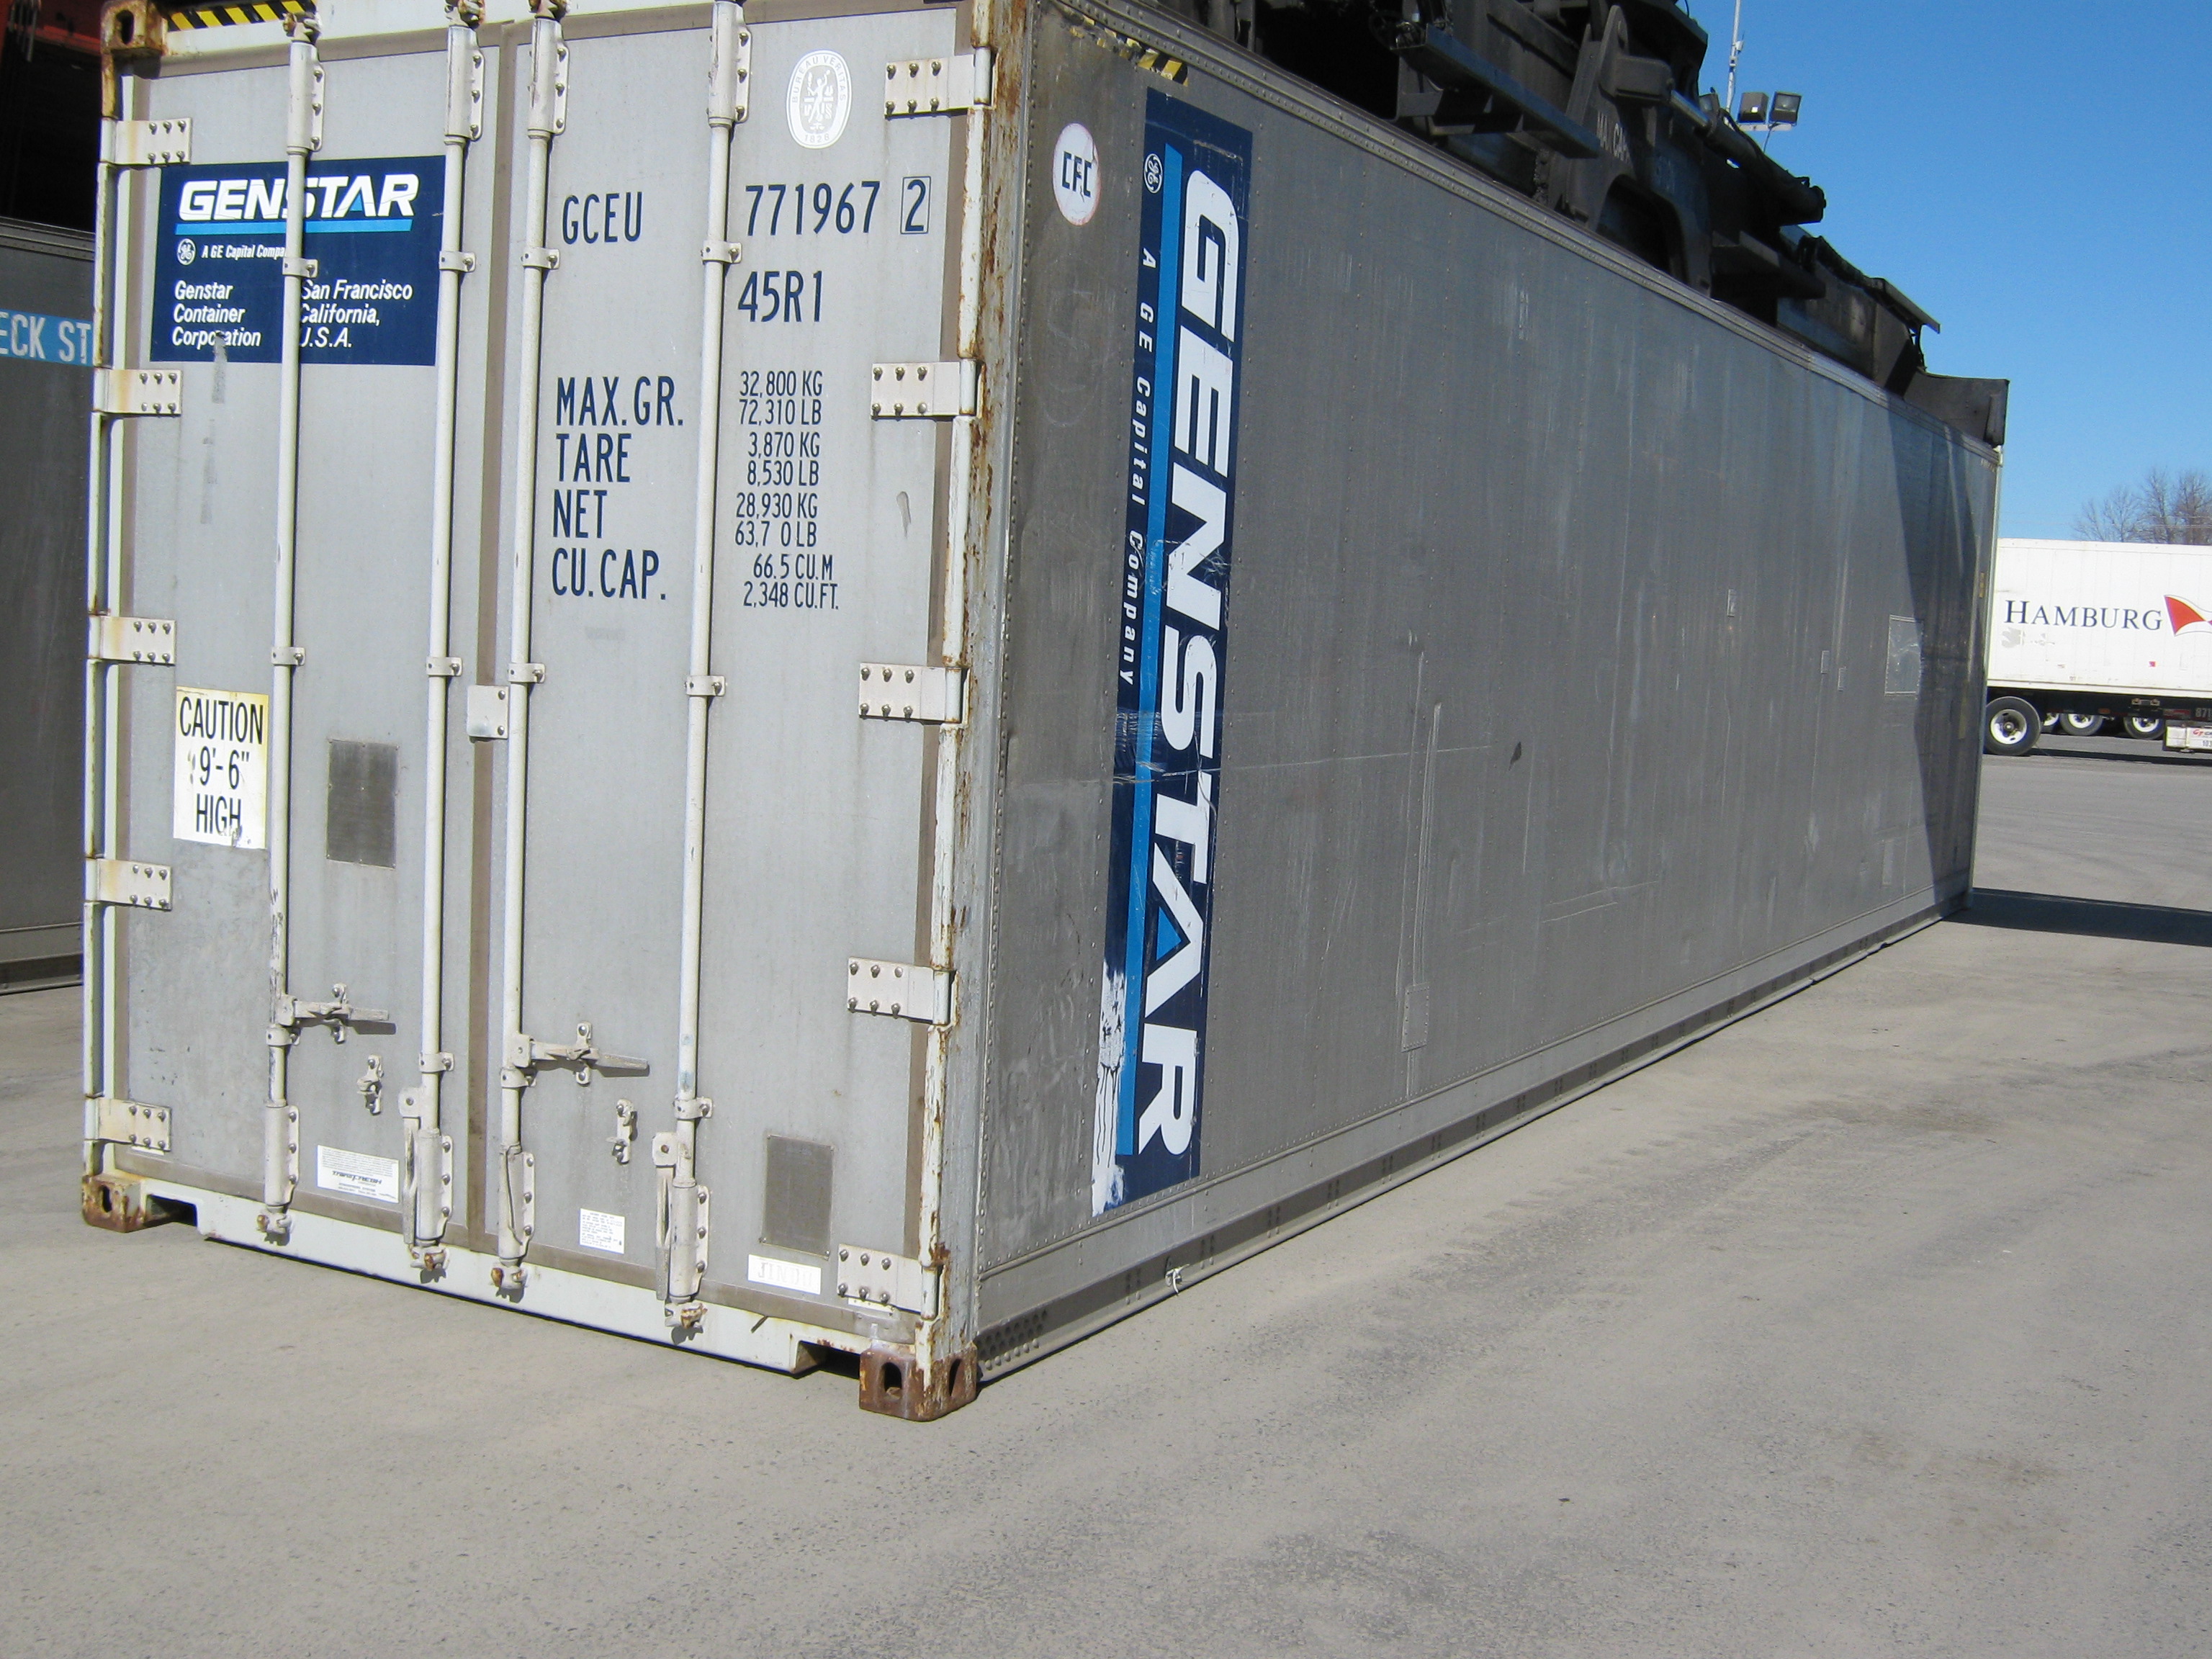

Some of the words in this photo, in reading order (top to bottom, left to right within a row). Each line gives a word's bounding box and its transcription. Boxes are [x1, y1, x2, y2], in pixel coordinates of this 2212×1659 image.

[791, 55, 819, 103] BUREAU
[822, 55, 846, 102] VERITAS
[1061, 150, 1092, 197] CFC
[179, 173, 420, 222] GENSTAR
[562, 191, 643, 244] GCEU
[745, 181, 881, 236] 771967
[904, 179, 927, 232] 2
[202, 245, 209, 258] A
[210, 245, 224, 258] GE
[225, 245, 256, 261] Capital
[256, 244, 286, 260] Compa
[1143, 248, 1156, 269] A
[174, 279, 234, 300] Genstar
[302, 279, 331, 300] San
[333, 279, 413, 300] Francisco
[738, 270, 823, 323] 45R1
[173, 302, 246, 324] Container
[301, 302, 380, 326] California,
[1138, 301, 1155, 352] GE
[739, 370, 797, 397] 32,800
[801, 370, 823, 397] KG
[739, 399, 796, 426] 72,310
[800, 399, 822, 426] LB
[747, 431, 793, 459] 3,870
[799, 431, 821, 458] KG
[1130, 374, 1151, 505] Capital
[555, 433, 632, 483] TARE
[747, 459, 793, 487] 8,530
[798, 459, 819, 486] LB
[553, 489, 608, 539] NET
[736, 492, 792, 519] 28,930
[796, 492, 818, 519] KG
[796, 521, 817, 547] LB
[753, 553, 790, 580] 66.5
[743, 580, 789, 609] 2,348
[1118, 529, 1145, 685] Company
[1138, 168, 1240, 1156] GENSTAR
[180, 696, 264, 745] CAUTION
[196, 793, 242, 835] HIGH
